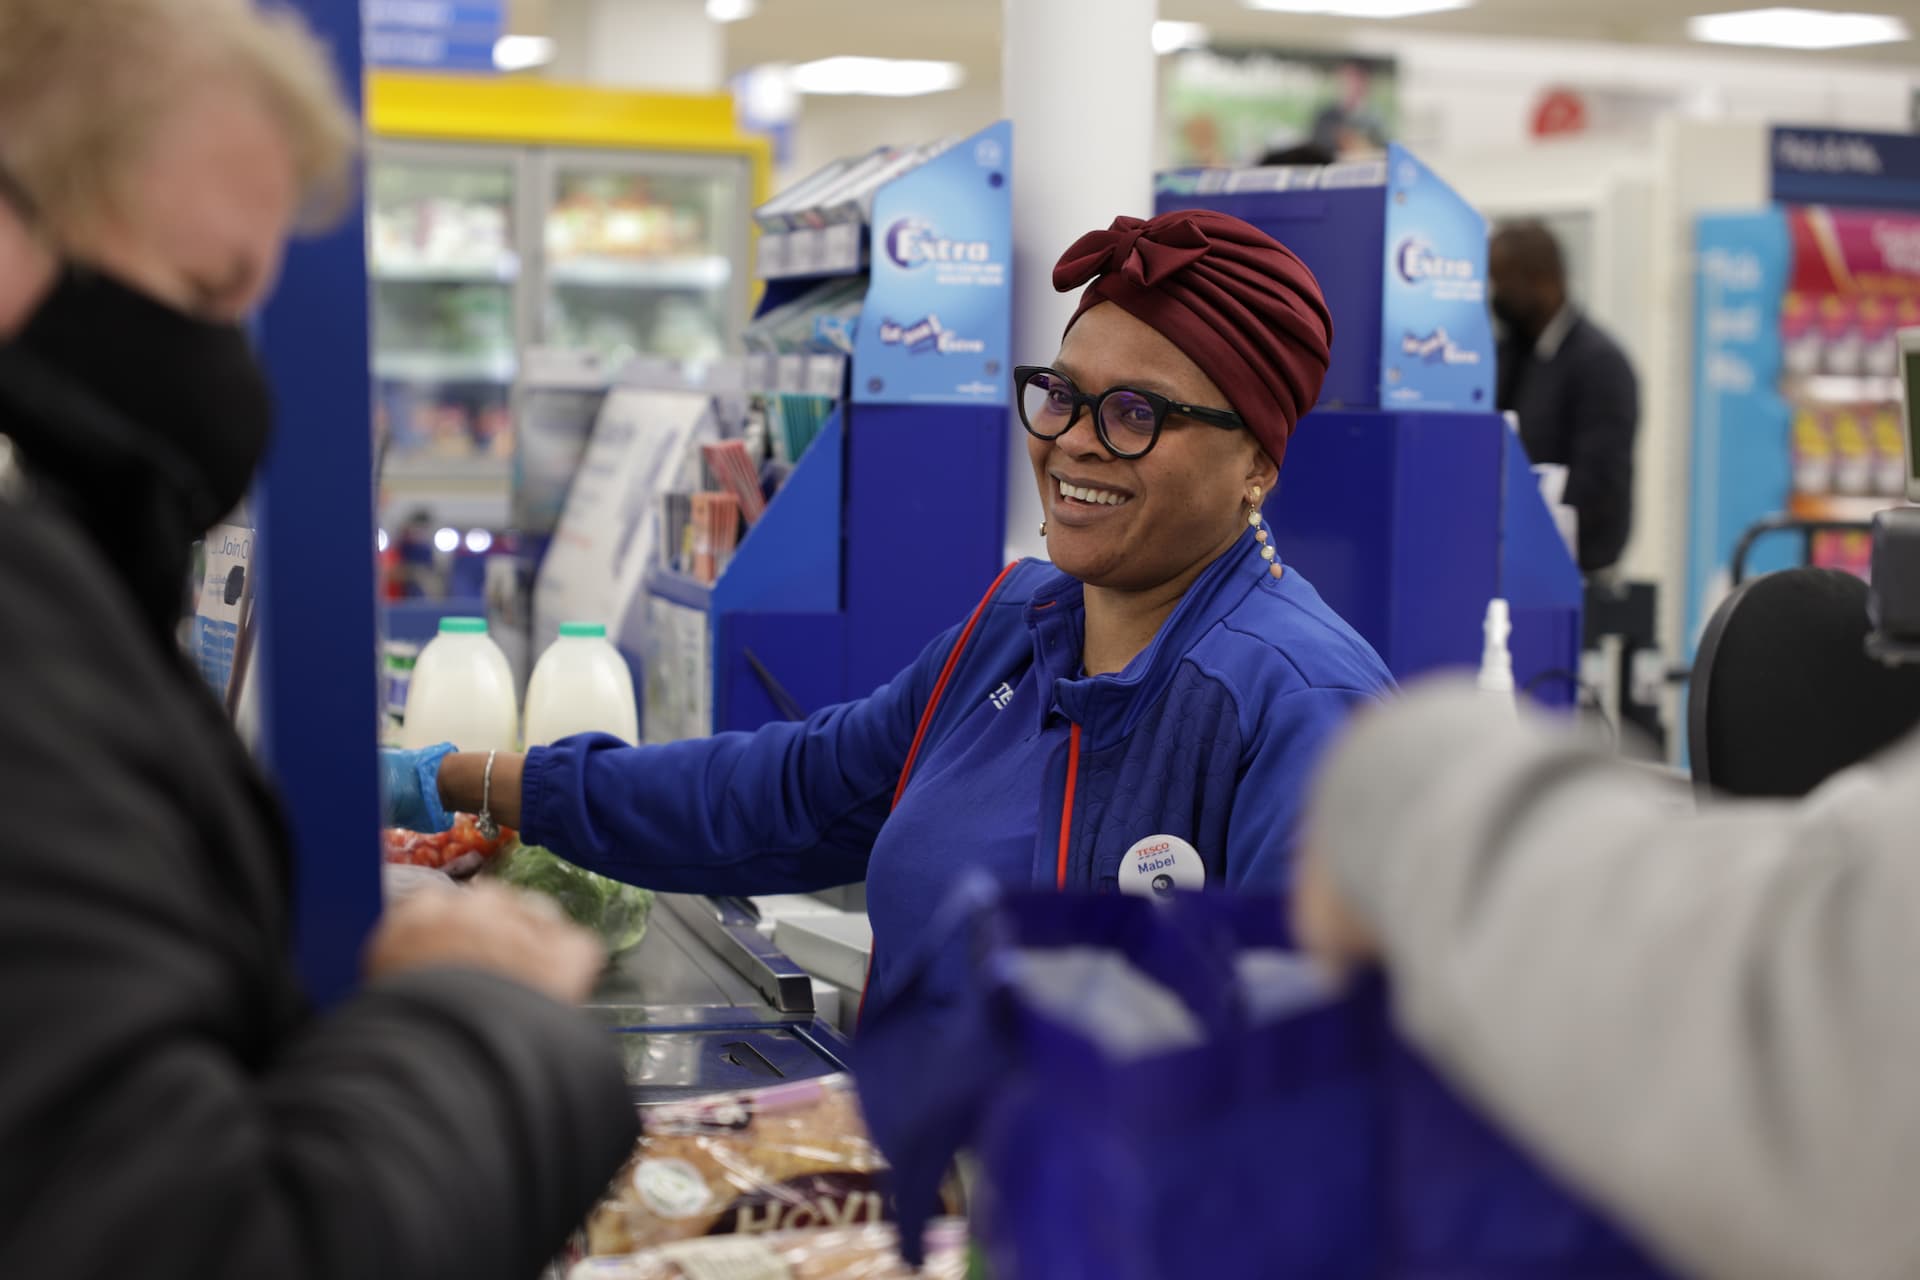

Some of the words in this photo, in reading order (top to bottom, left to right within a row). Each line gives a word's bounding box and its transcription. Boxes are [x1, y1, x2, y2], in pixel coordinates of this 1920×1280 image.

[896, 227, 990, 262] Extra
[1136, 842, 1169, 857] TESCO
[1137, 854, 1176, 874] Mabel
[735, 1191, 884, 1233] HOVI
